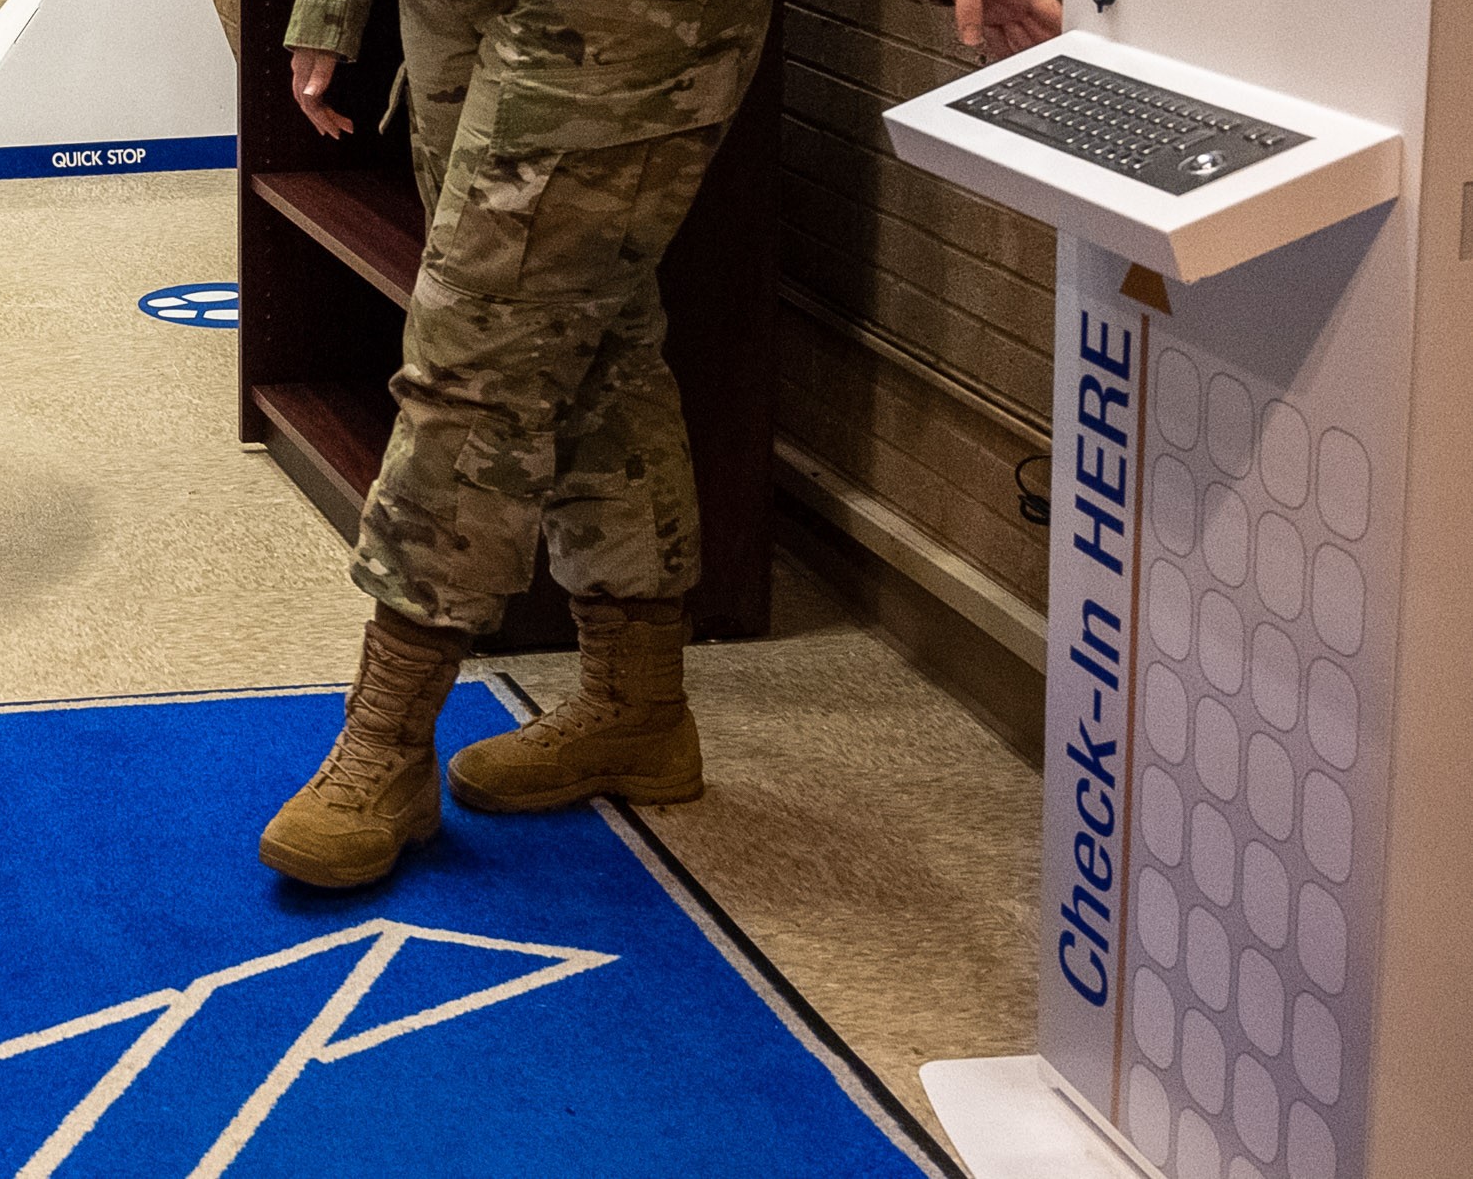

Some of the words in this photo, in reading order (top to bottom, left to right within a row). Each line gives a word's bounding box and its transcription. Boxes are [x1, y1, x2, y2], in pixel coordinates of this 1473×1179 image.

[52, 151, 103, 168] QUICK
[107, 148, 146, 164] STOP
[1072, 310, 1134, 576] HERE
[1058, 597, 1121, 1007] Check-In
